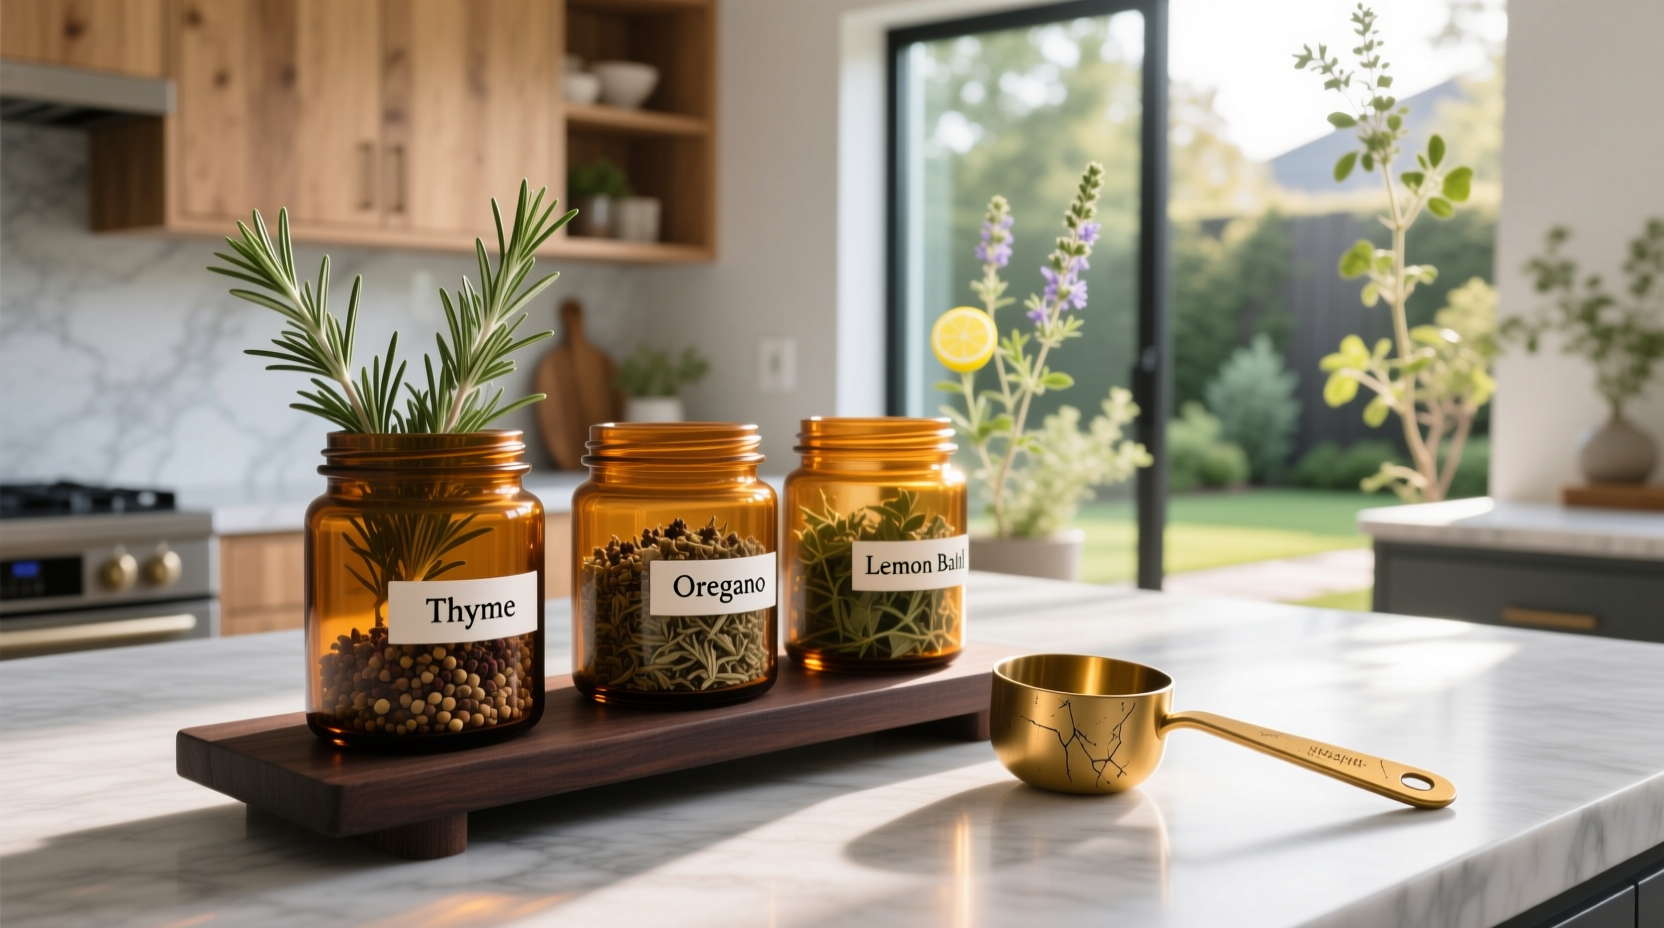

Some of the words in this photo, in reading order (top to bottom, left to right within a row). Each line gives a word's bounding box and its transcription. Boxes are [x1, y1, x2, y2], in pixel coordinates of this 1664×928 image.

[865, 555, 932, 575] Lemon
[673, 574, 766, 604] Oregano
[426, 596, 516, 630] Thyme
